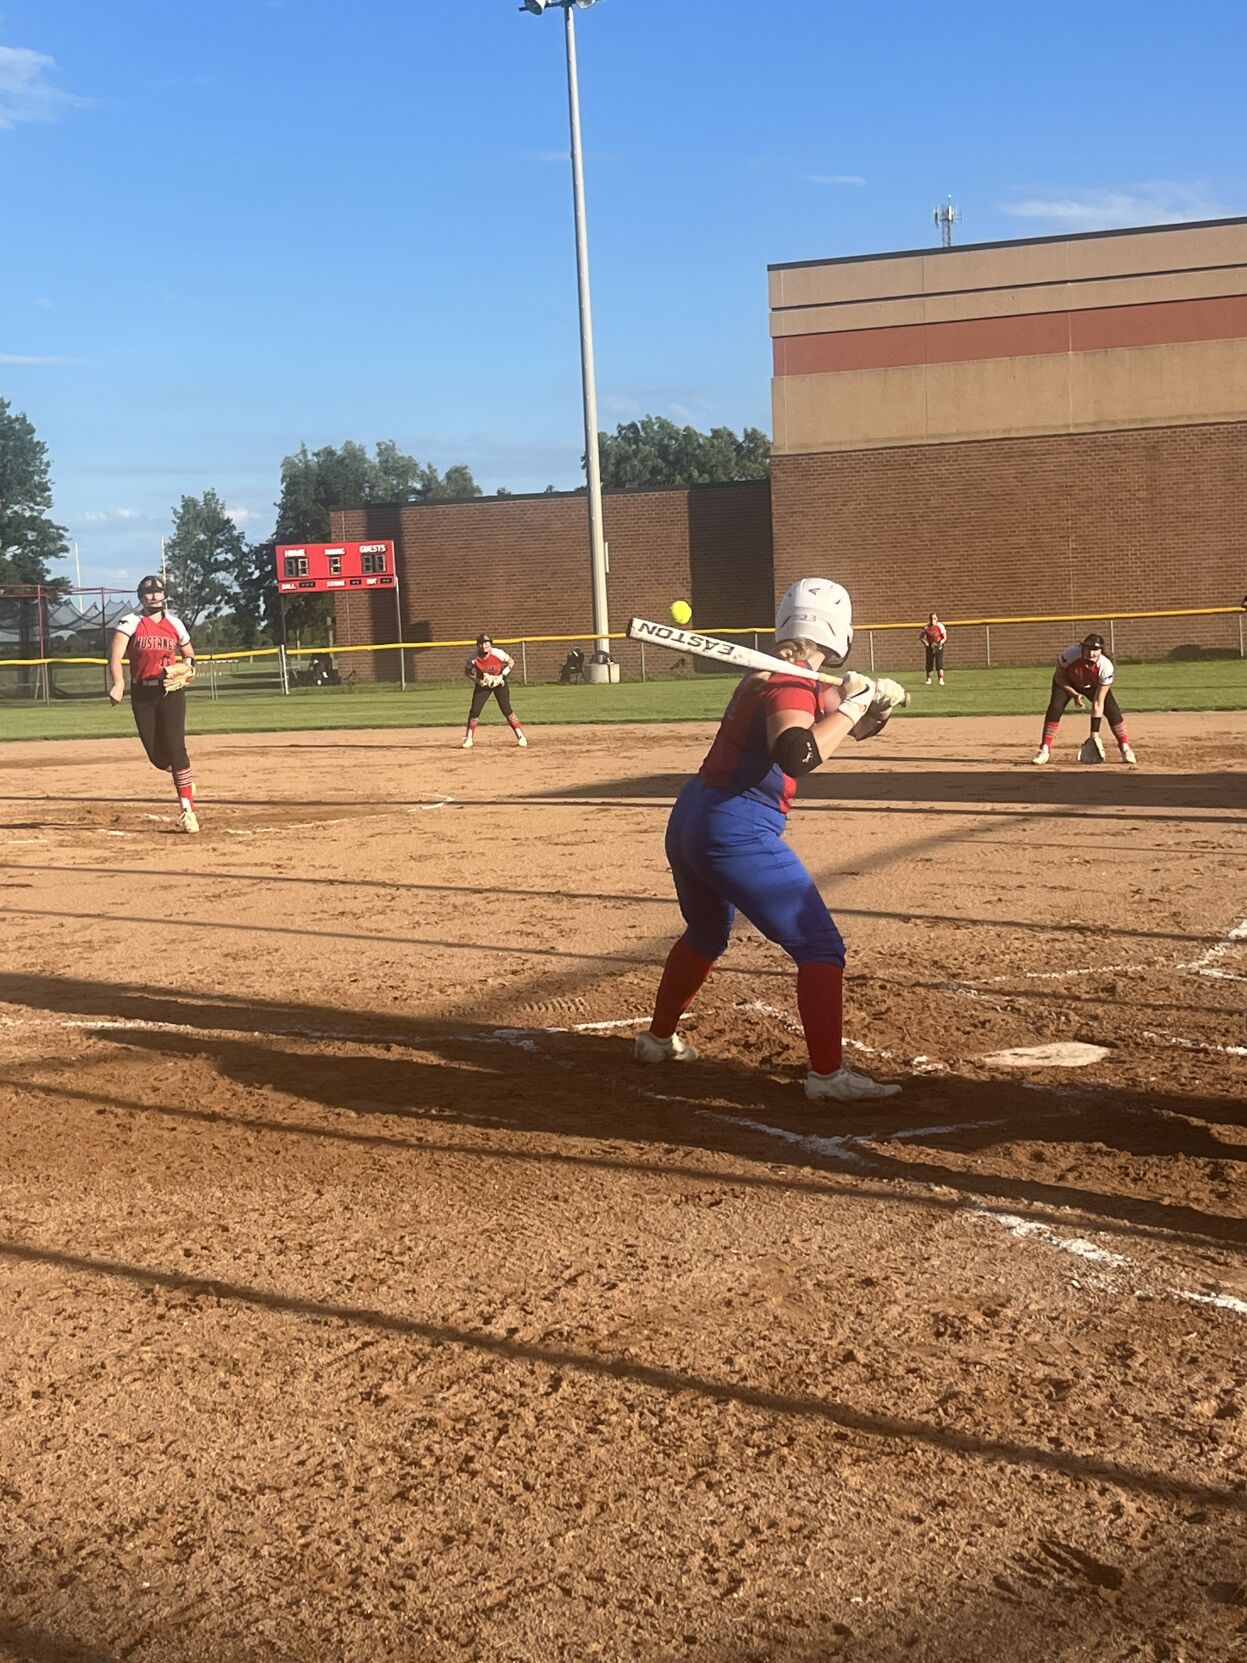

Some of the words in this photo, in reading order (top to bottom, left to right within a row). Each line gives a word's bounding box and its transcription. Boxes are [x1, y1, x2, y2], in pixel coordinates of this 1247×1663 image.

[359, 544, 386, 553] GUESTS
[800, 613, 818, 622] 23
[638, 622, 735, 656] EASTON
